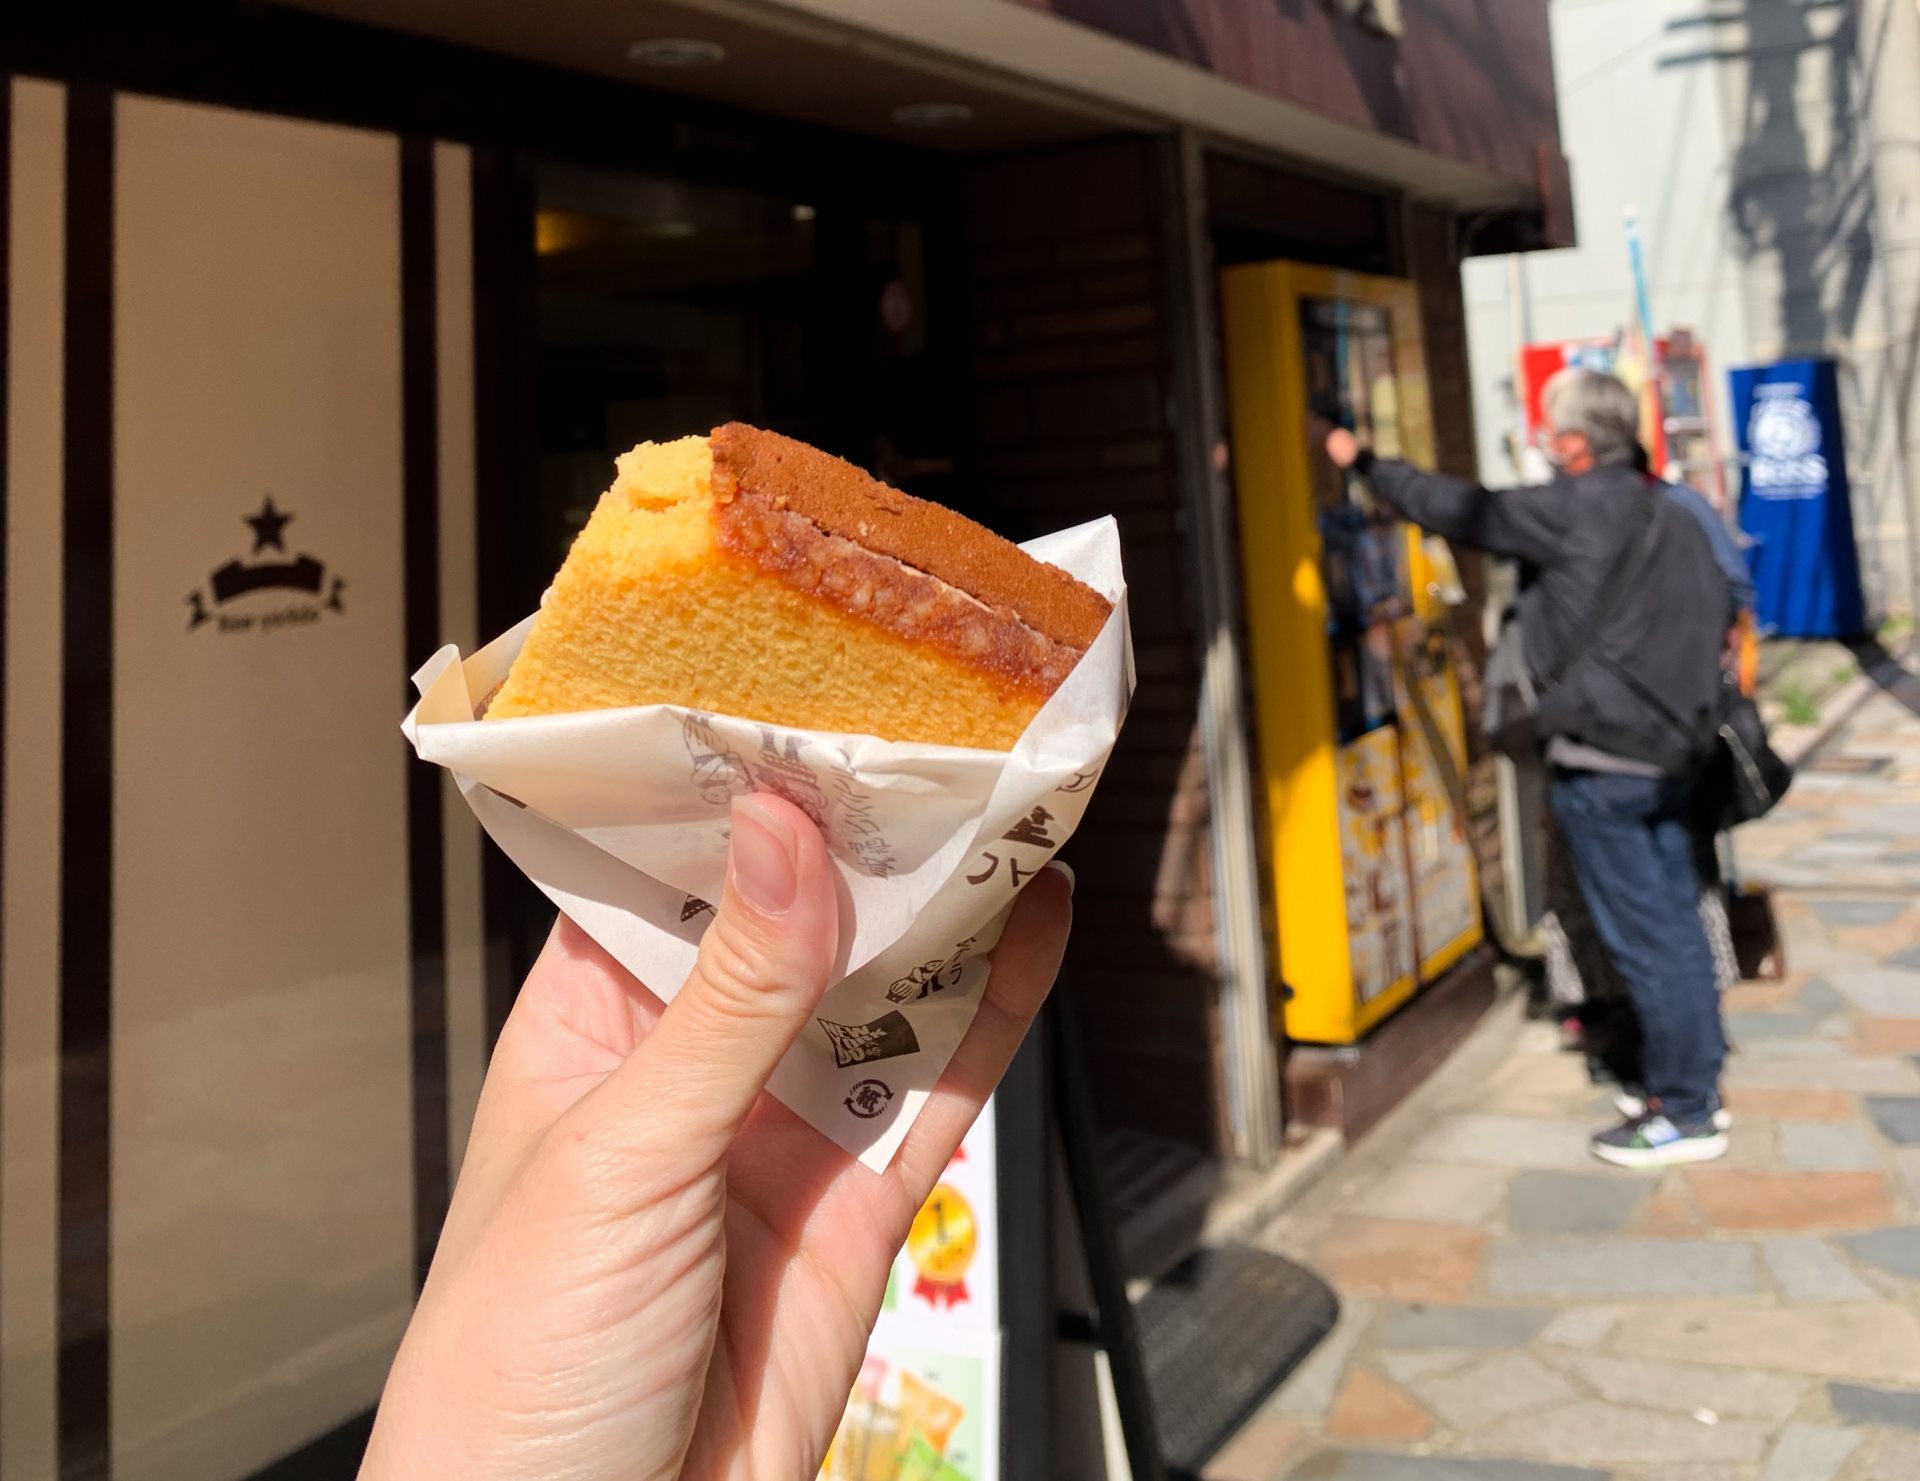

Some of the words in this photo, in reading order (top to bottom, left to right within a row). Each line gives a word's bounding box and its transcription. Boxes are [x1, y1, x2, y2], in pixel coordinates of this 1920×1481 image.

[819, 1020, 870, 1041] NEW
[828, 1027, 888, 1050] YORK
[838, 1047, 865, 1065] DO
